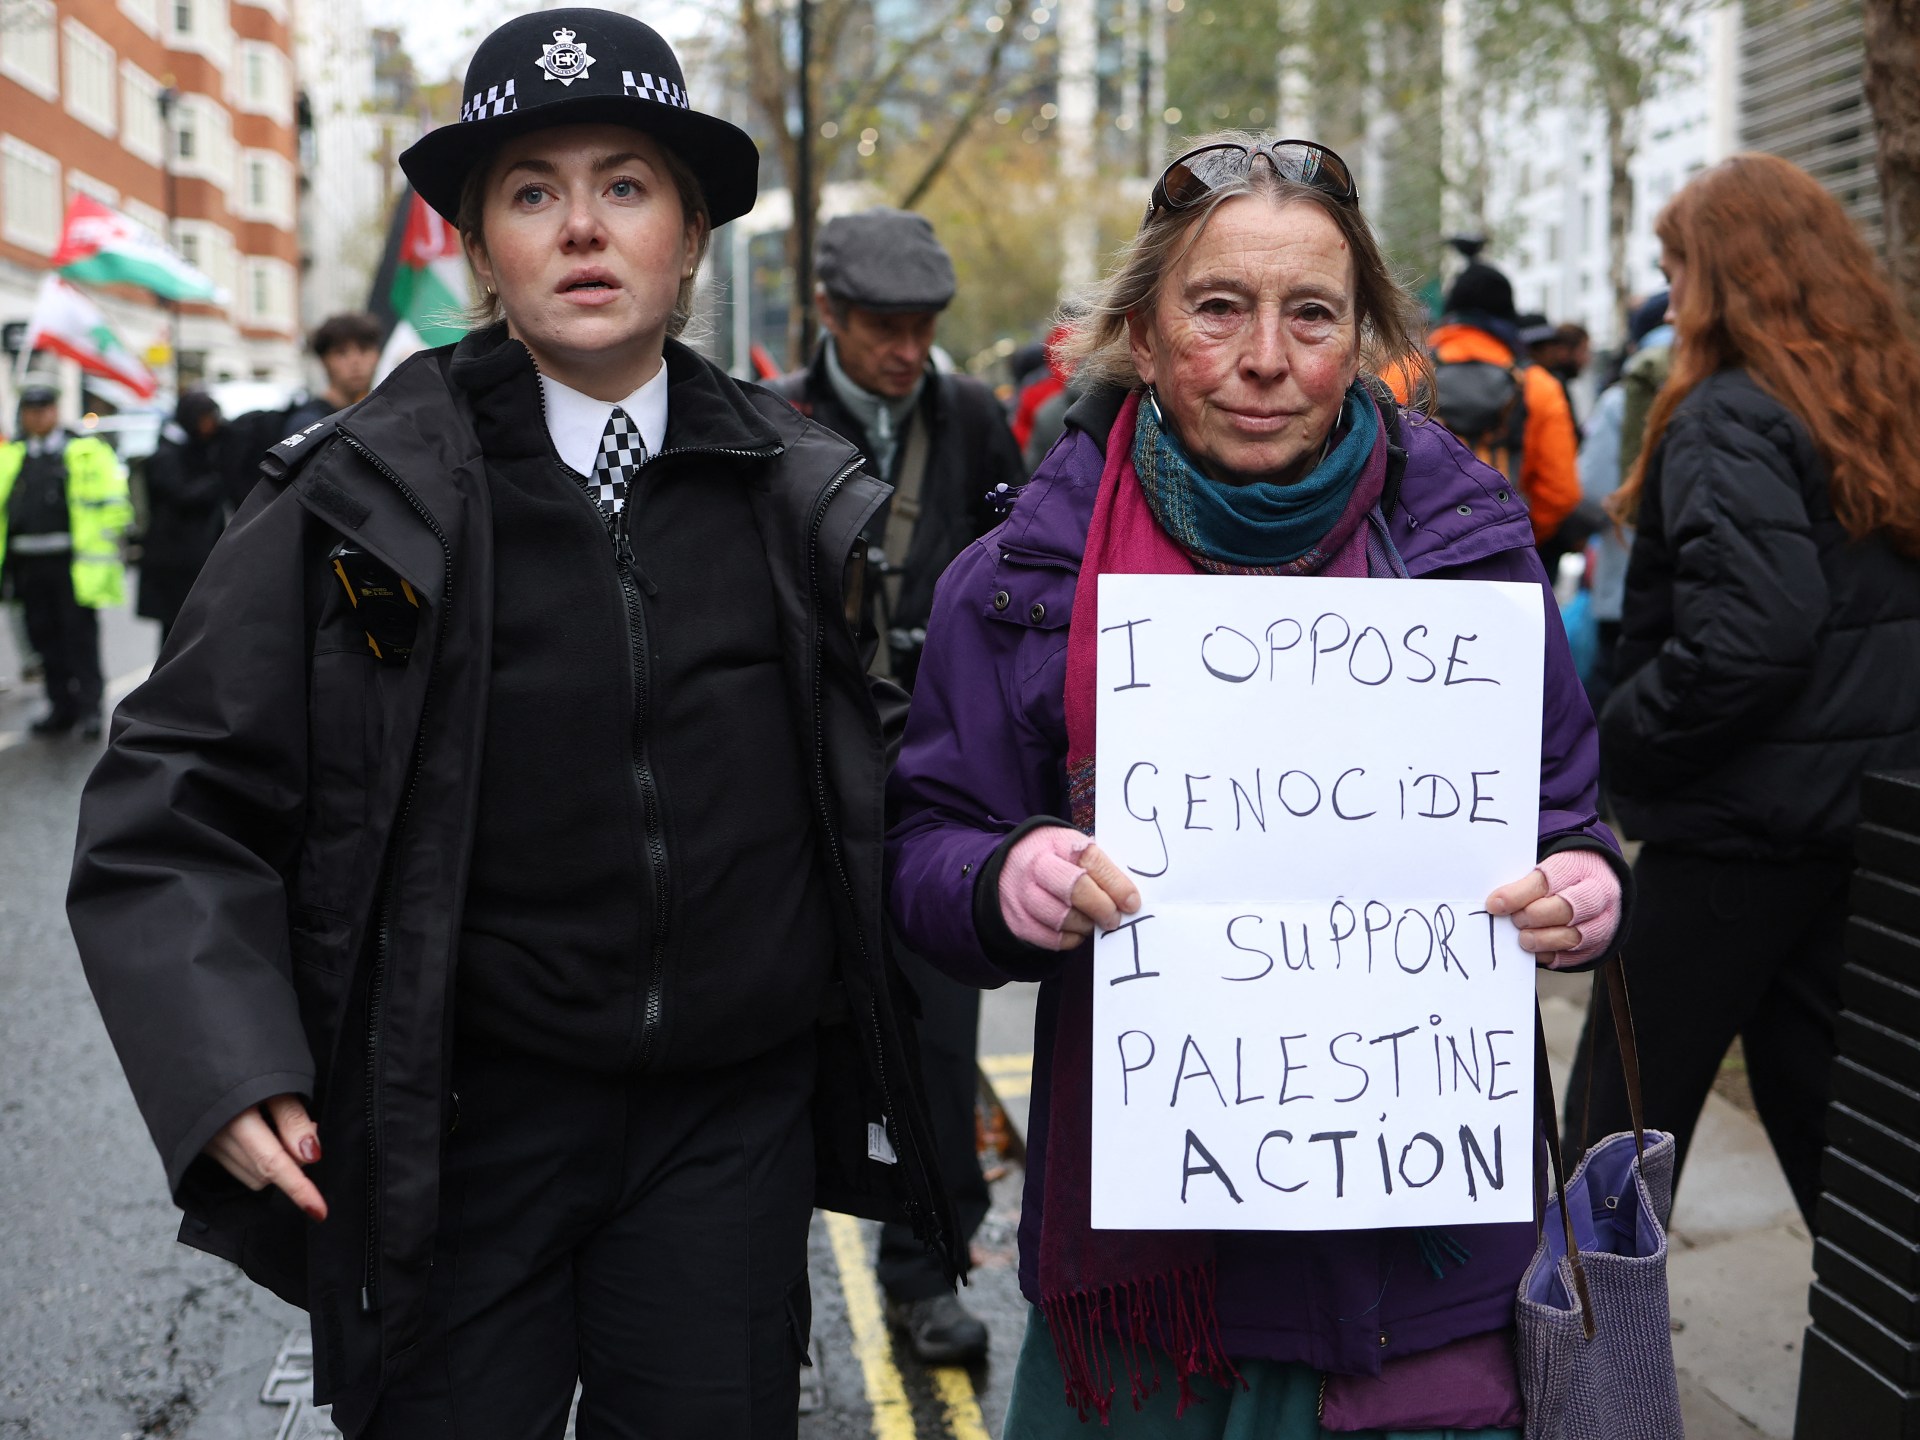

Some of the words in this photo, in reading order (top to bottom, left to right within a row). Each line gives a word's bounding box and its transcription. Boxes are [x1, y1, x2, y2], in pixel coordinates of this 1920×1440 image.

[1101, 618, 1152, 692] I
[1201, 612, 1501, 686] OPPOSE
[1100, 914, 1160, 986] I
[1221, 895, 1498, 981] SUPPORT
